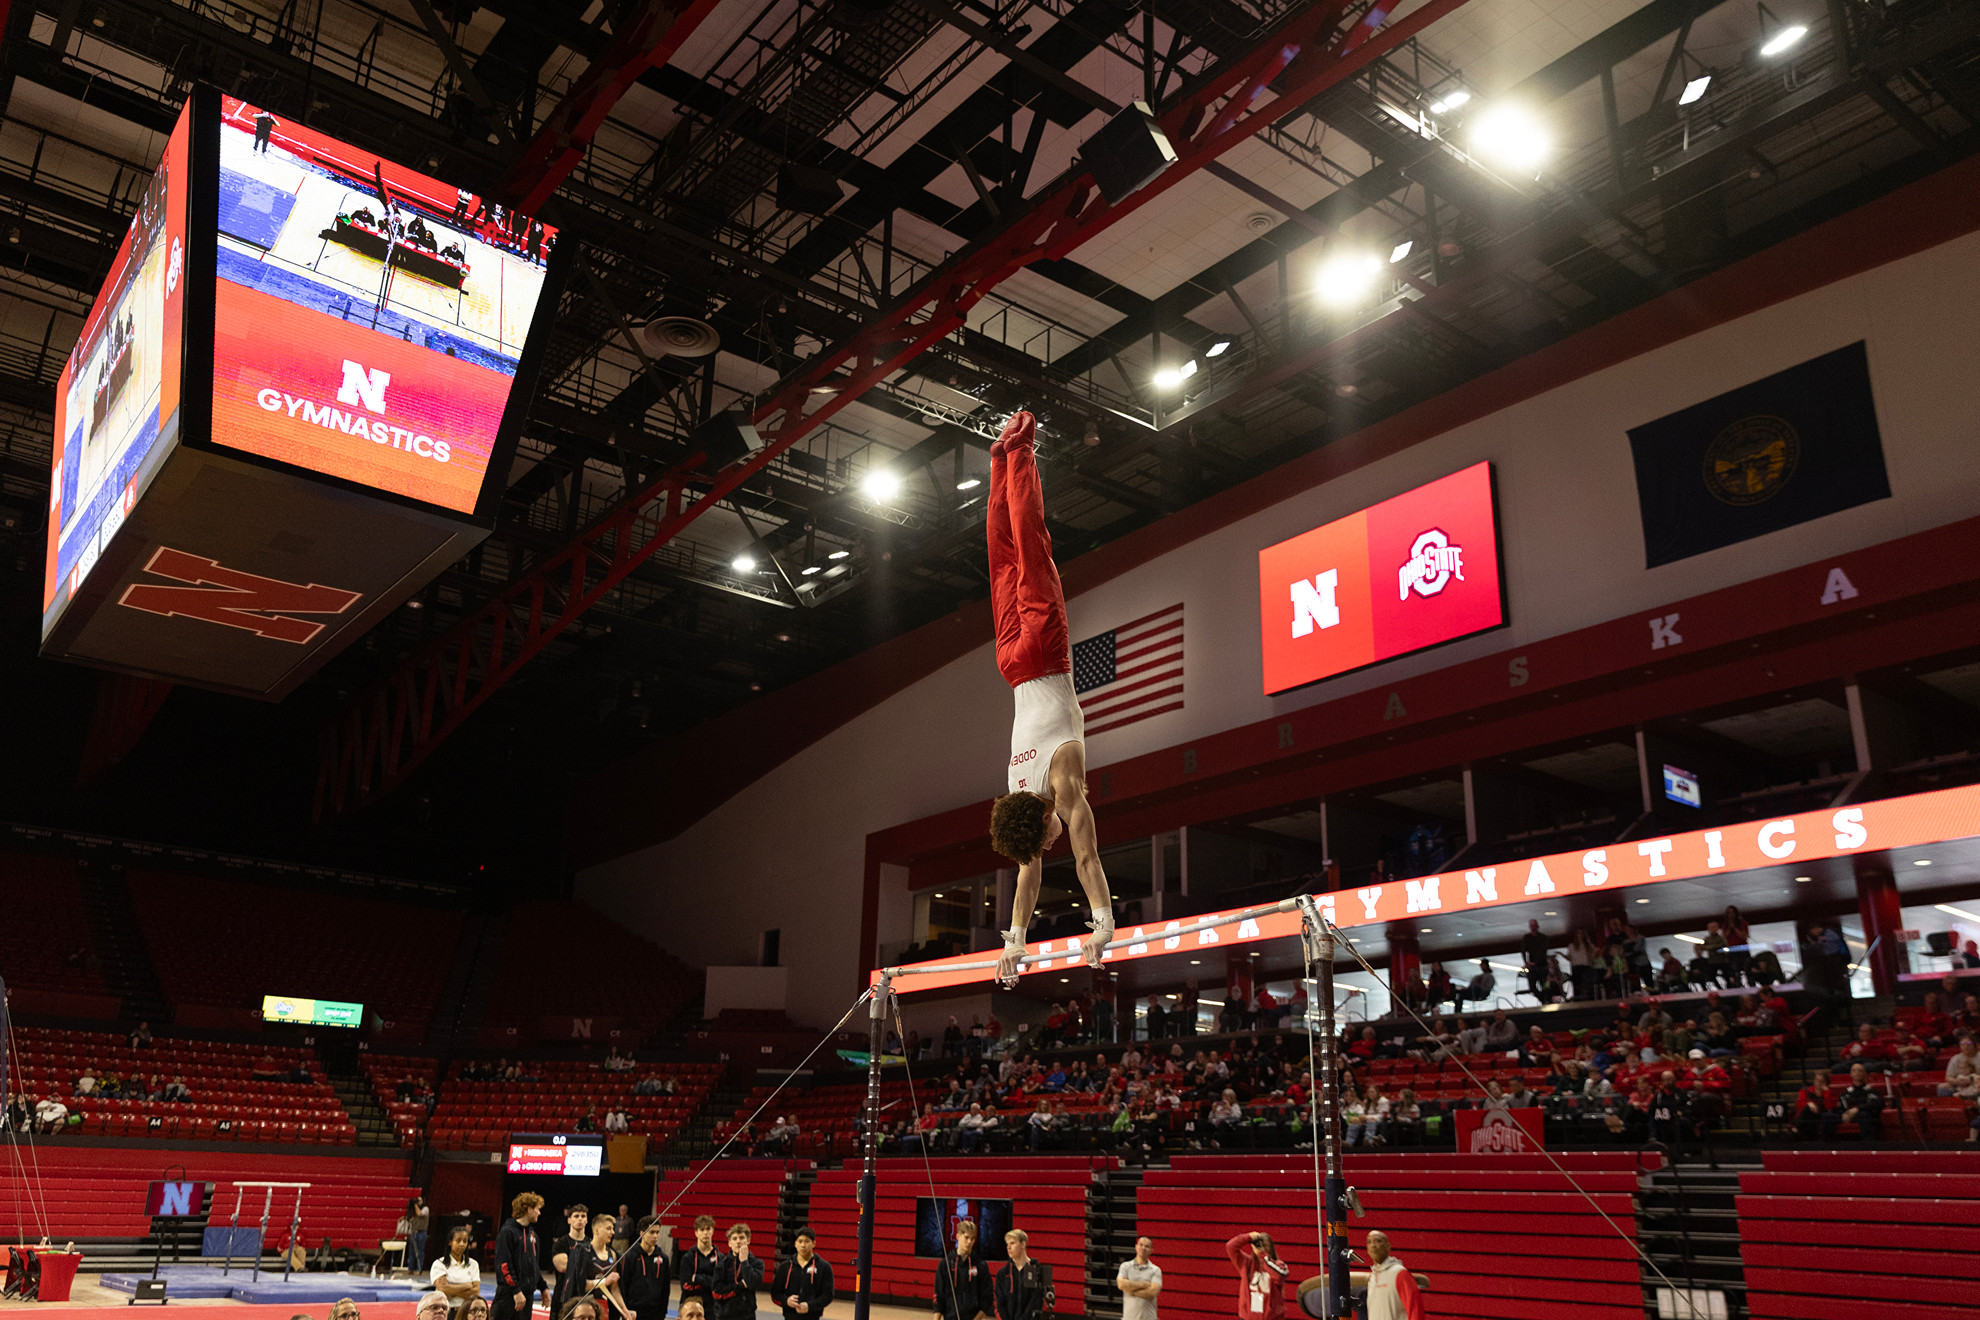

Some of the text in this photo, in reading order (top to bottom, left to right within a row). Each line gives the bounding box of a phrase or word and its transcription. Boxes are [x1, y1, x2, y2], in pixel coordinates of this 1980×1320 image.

[336, 358, 391, 415] N
[256, 388, 451, 463] GYMNASTICS
[1289, 567, 1341, 639] N
[571, 1018, 593, 1038] N
[150, 1118, 161, 1127] A4
[1766, 1104, 1785, 1118] A9
[220, 1122, 231, 1130] A5
[159, 1183, 194, 1215] N
